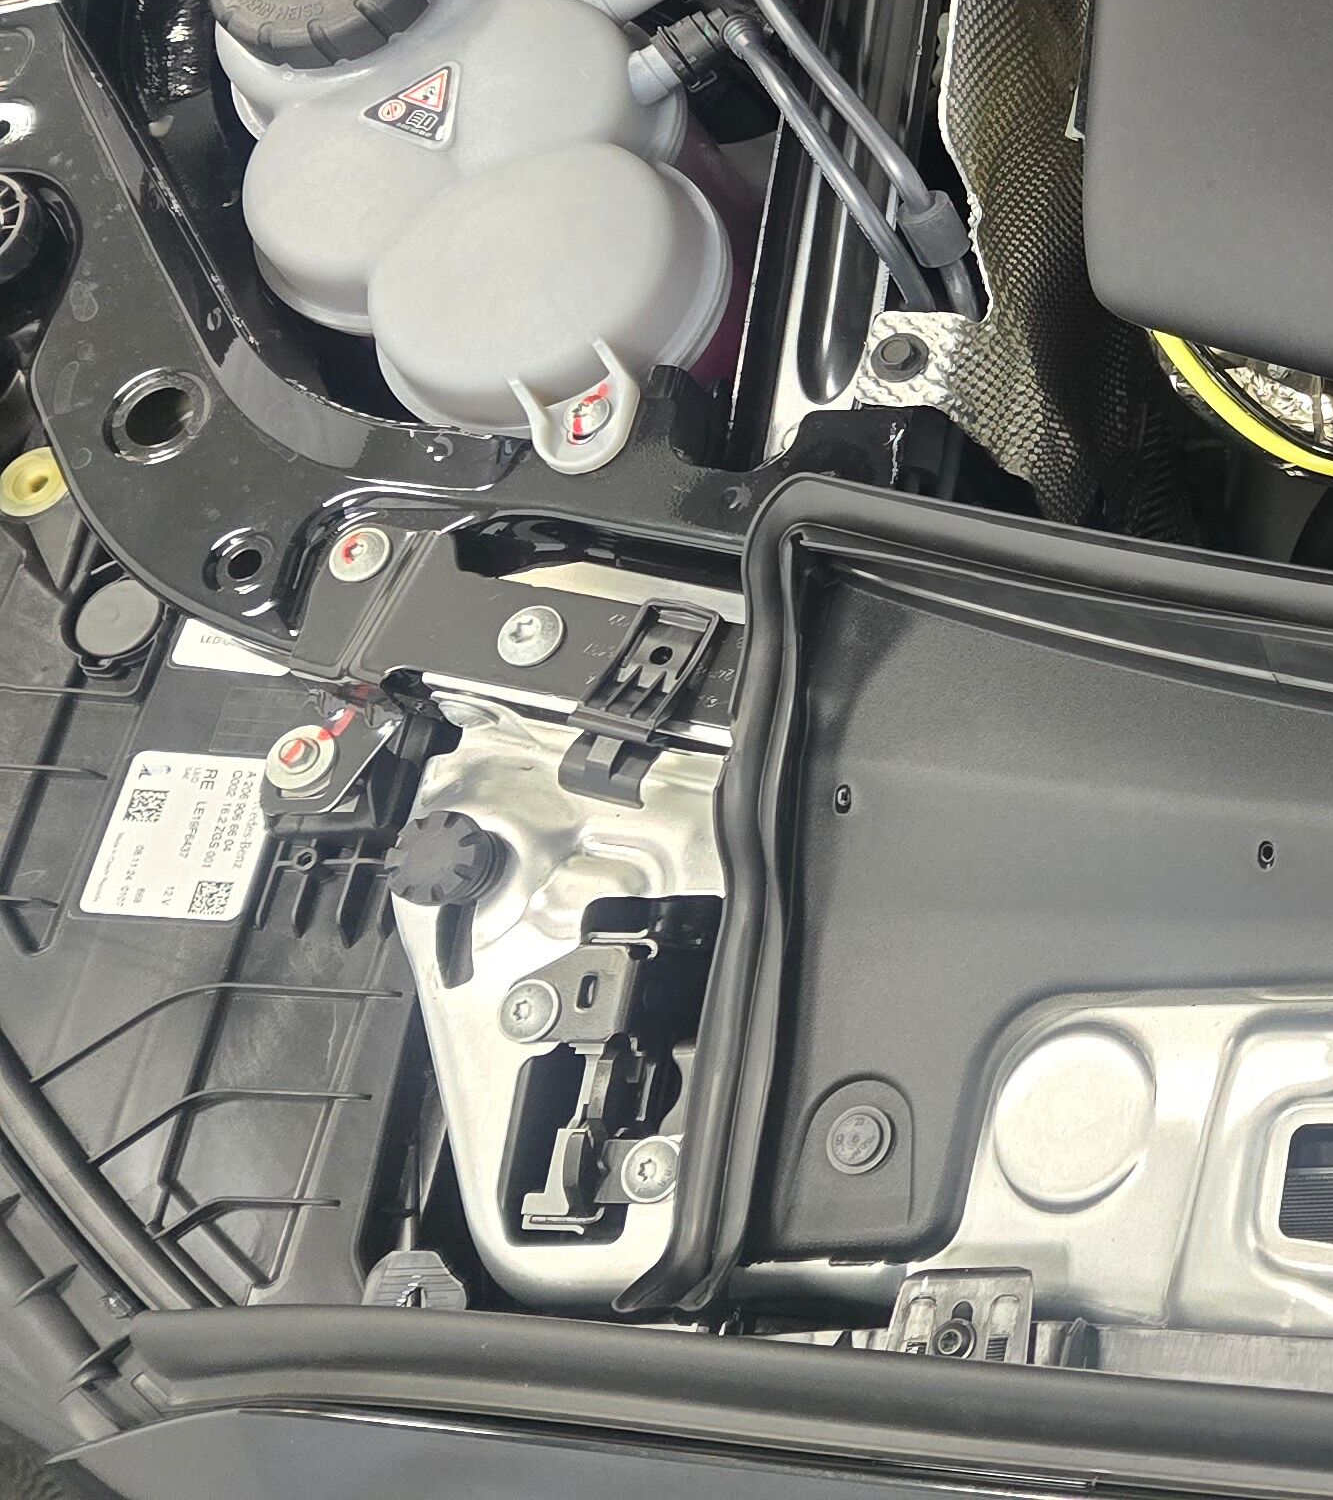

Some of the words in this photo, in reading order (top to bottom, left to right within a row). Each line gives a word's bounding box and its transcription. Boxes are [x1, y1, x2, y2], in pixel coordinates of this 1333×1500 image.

[276, 2, 324, 20] HEISS
[199, 769, 218, 791] RE
[225, 771, 242, 797] Q002
[238, 781, 253, 799] 206
[209, 826, 226, 848] ZGS
